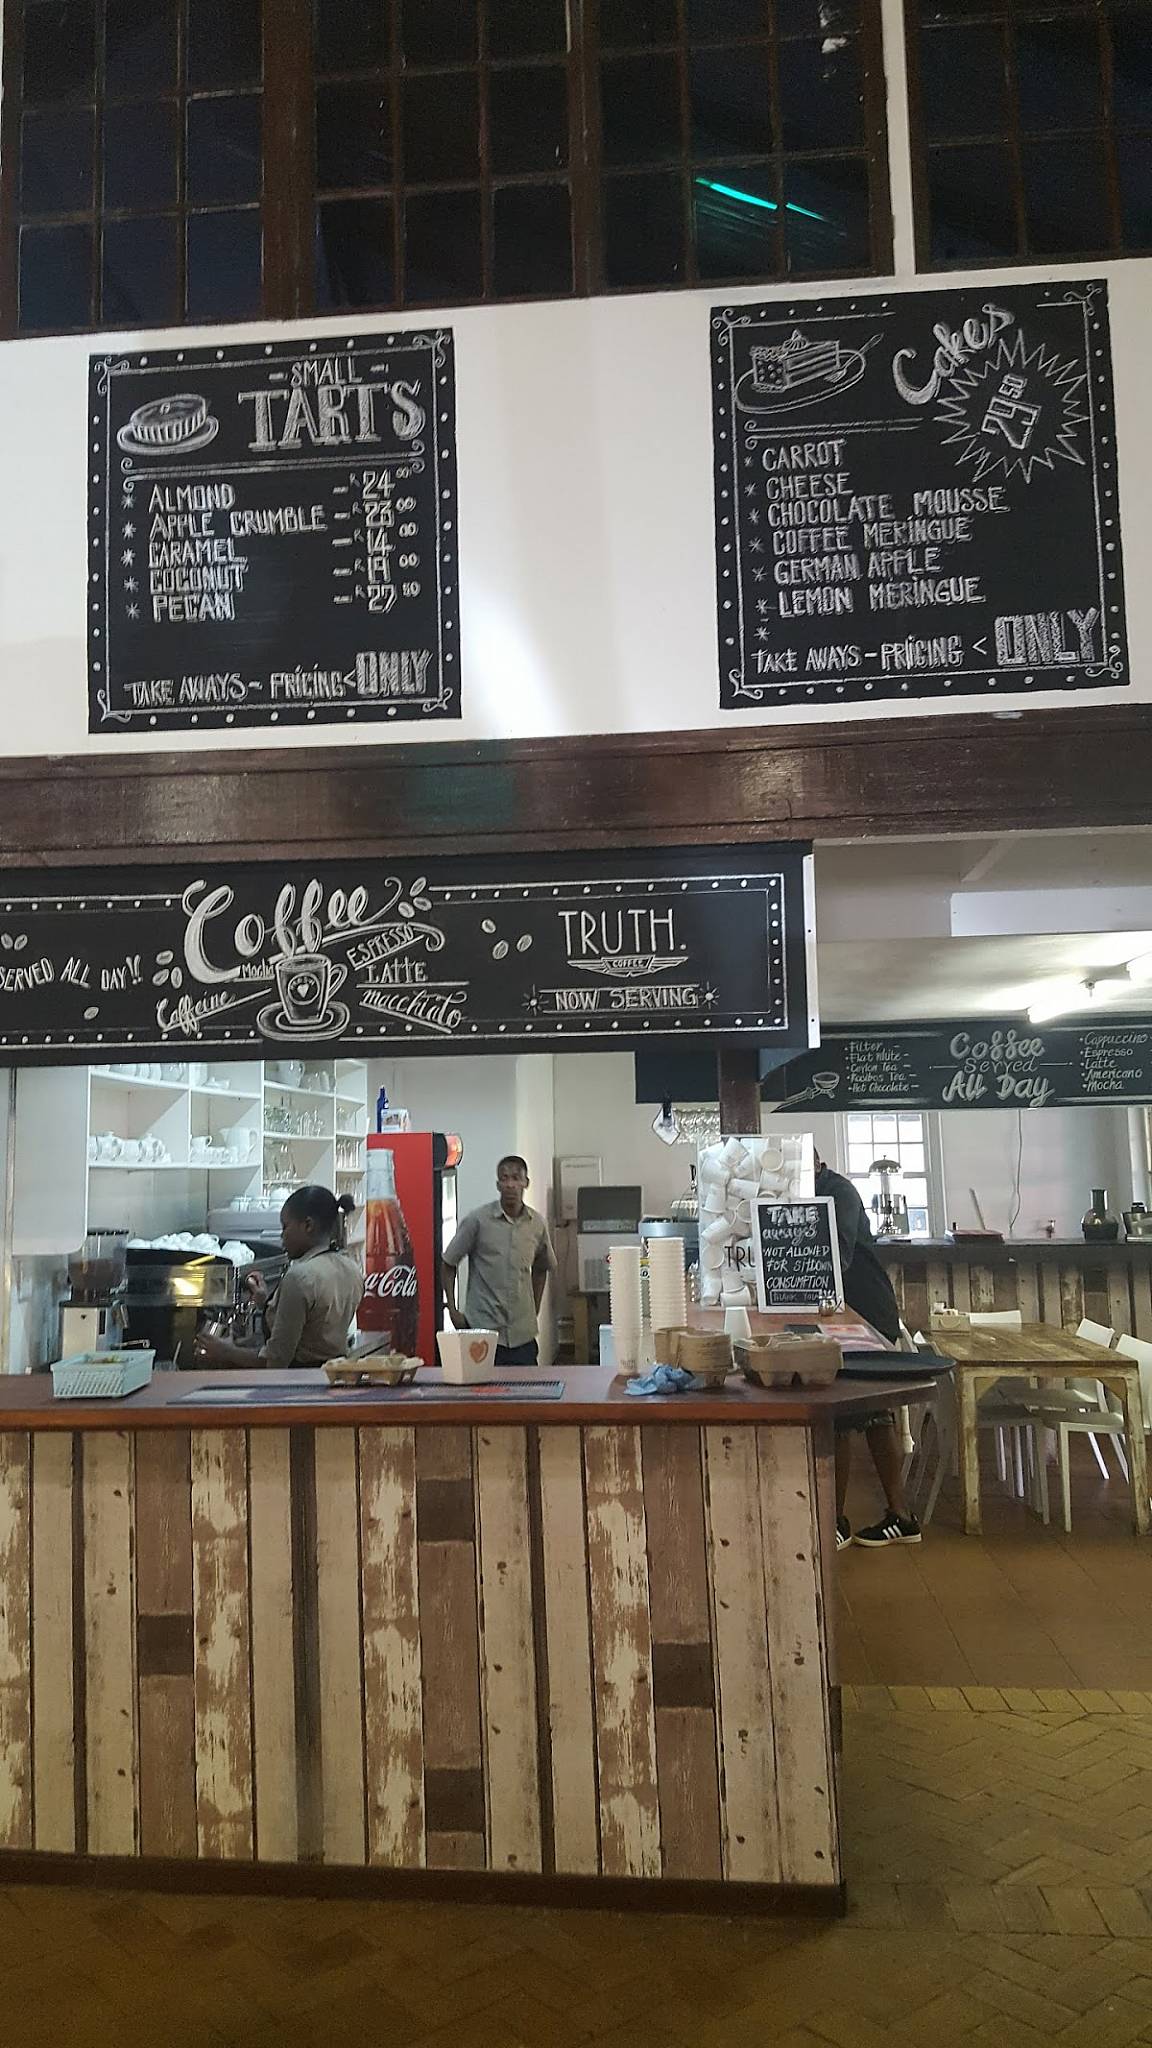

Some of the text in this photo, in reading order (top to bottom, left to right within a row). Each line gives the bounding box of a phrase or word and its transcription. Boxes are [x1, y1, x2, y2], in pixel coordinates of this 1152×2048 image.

[893, 304, 1015, 405] Cakes
[291, 357, 362, 387] SMALL
[238, 380, 426, 451] TARTS
[762, 439, 846, 471] CARROT
[149, 483, 235, 513] ALMOND
[766, 472, 853, 500] CHEESE
[768, 486, 1010, 528] CHOCOLATE MOUSSE
[149, 512, 215, 540] APPLE
[230, 505, 328, 537] CRUMBLE
[149, 538, 247, 568] CARAMEL
[772, 525, 852, 556] COFFEE
[150, 564, 248, 595] COCONUT
[774, 547, 943, 585] GERMAN APPLE
[152, 593, 234, 622] PECAN
[778, 587, 853, 618] LEMON
[751, 647, 798, 674] TAKE
[995, 607, 1099, 666] ONLY
[124, 679, 174, 706] TAKE
[354, 649, 434, 697] ONLY
[182, 876, 402, 984] Coffee
[347, 923, 414, 967] ESPRESSO
[0, 957, 55, 992] SERVED
[60, 957, 91, 988] ALL
[612, 958, 643, 969] COFFEE
[555, 985, 698, 1011] NOW SERVING
[156, 990, 236, 1038] Caffeine
[849, 1041, 882, 1053] Filter
[950, 1029, 1046, 1061] Coffee
[1084, 1031, 1148, 1048] Cappuccino
[1084, 1046, 1134, 1060] Espresso
[850, 1052, 873, 1063] Flat
[881, 1061, 898, 1072] Tea
[964, 1057, 1038, 1074] Served
[1085, 1056, 1118, 1070] Latte
[852, 1081, 911, 1093] Hot Chocolate
[889, 1071, 907, 1081] Tea
[942, 1070, 1056, 1107] All Day
[1084, 1068, 1143, 1081] Americano
[1086, 1078, 1126, 1092] Mocha
[767, 1206, 819, 1226] TAKE
[763, 1245, 830, 1258] NOT ALLOWED
[767, 1258, 788, 1272] FOR
